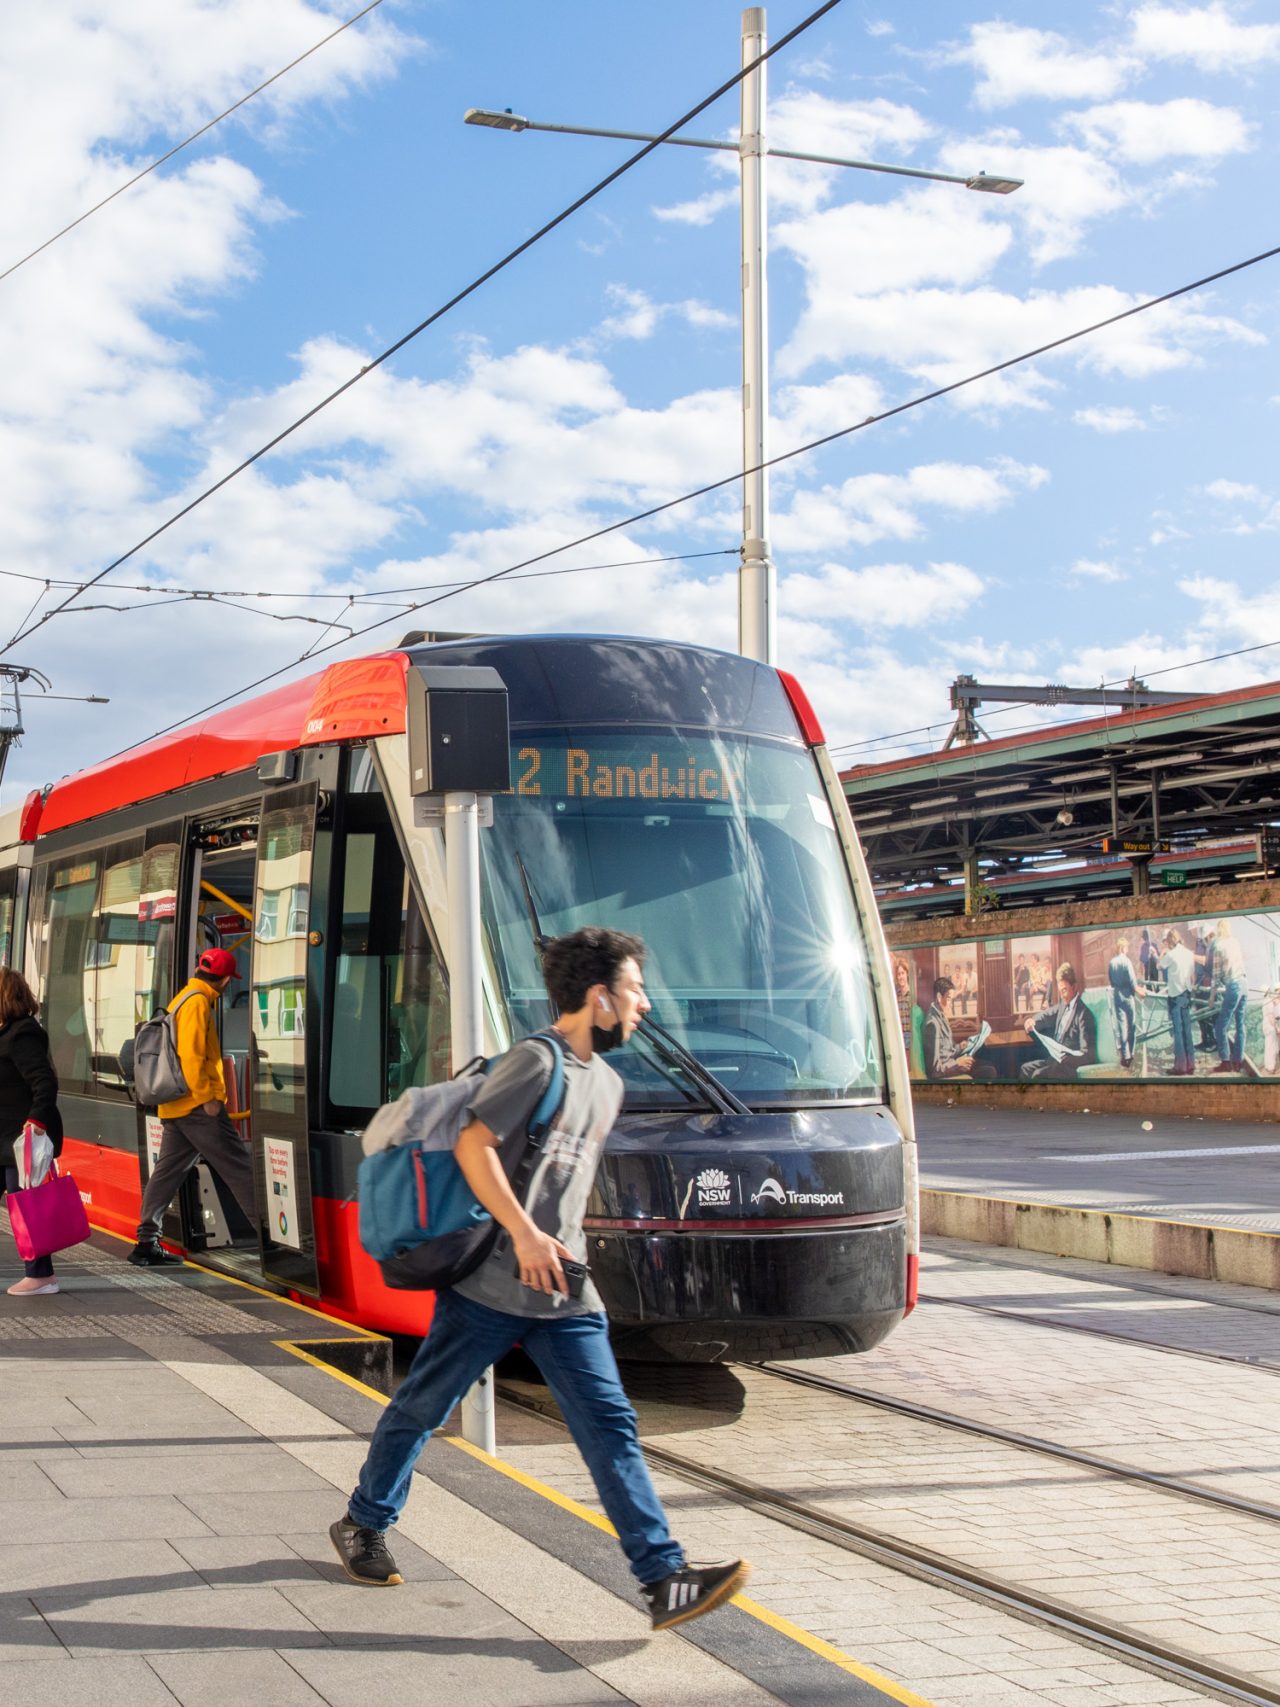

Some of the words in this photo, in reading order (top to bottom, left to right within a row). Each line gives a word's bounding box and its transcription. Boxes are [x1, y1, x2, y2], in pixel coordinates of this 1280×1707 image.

[504, 748, 541, 795] 2
[1123, 841, 1138, 851] Way
[1138, 842, 1151, 851] out
[1167, 875, 1185, 884] HELP
[698, 1189, 731, 1201] NSW
[786, 1190, 844, 1207] Transport
